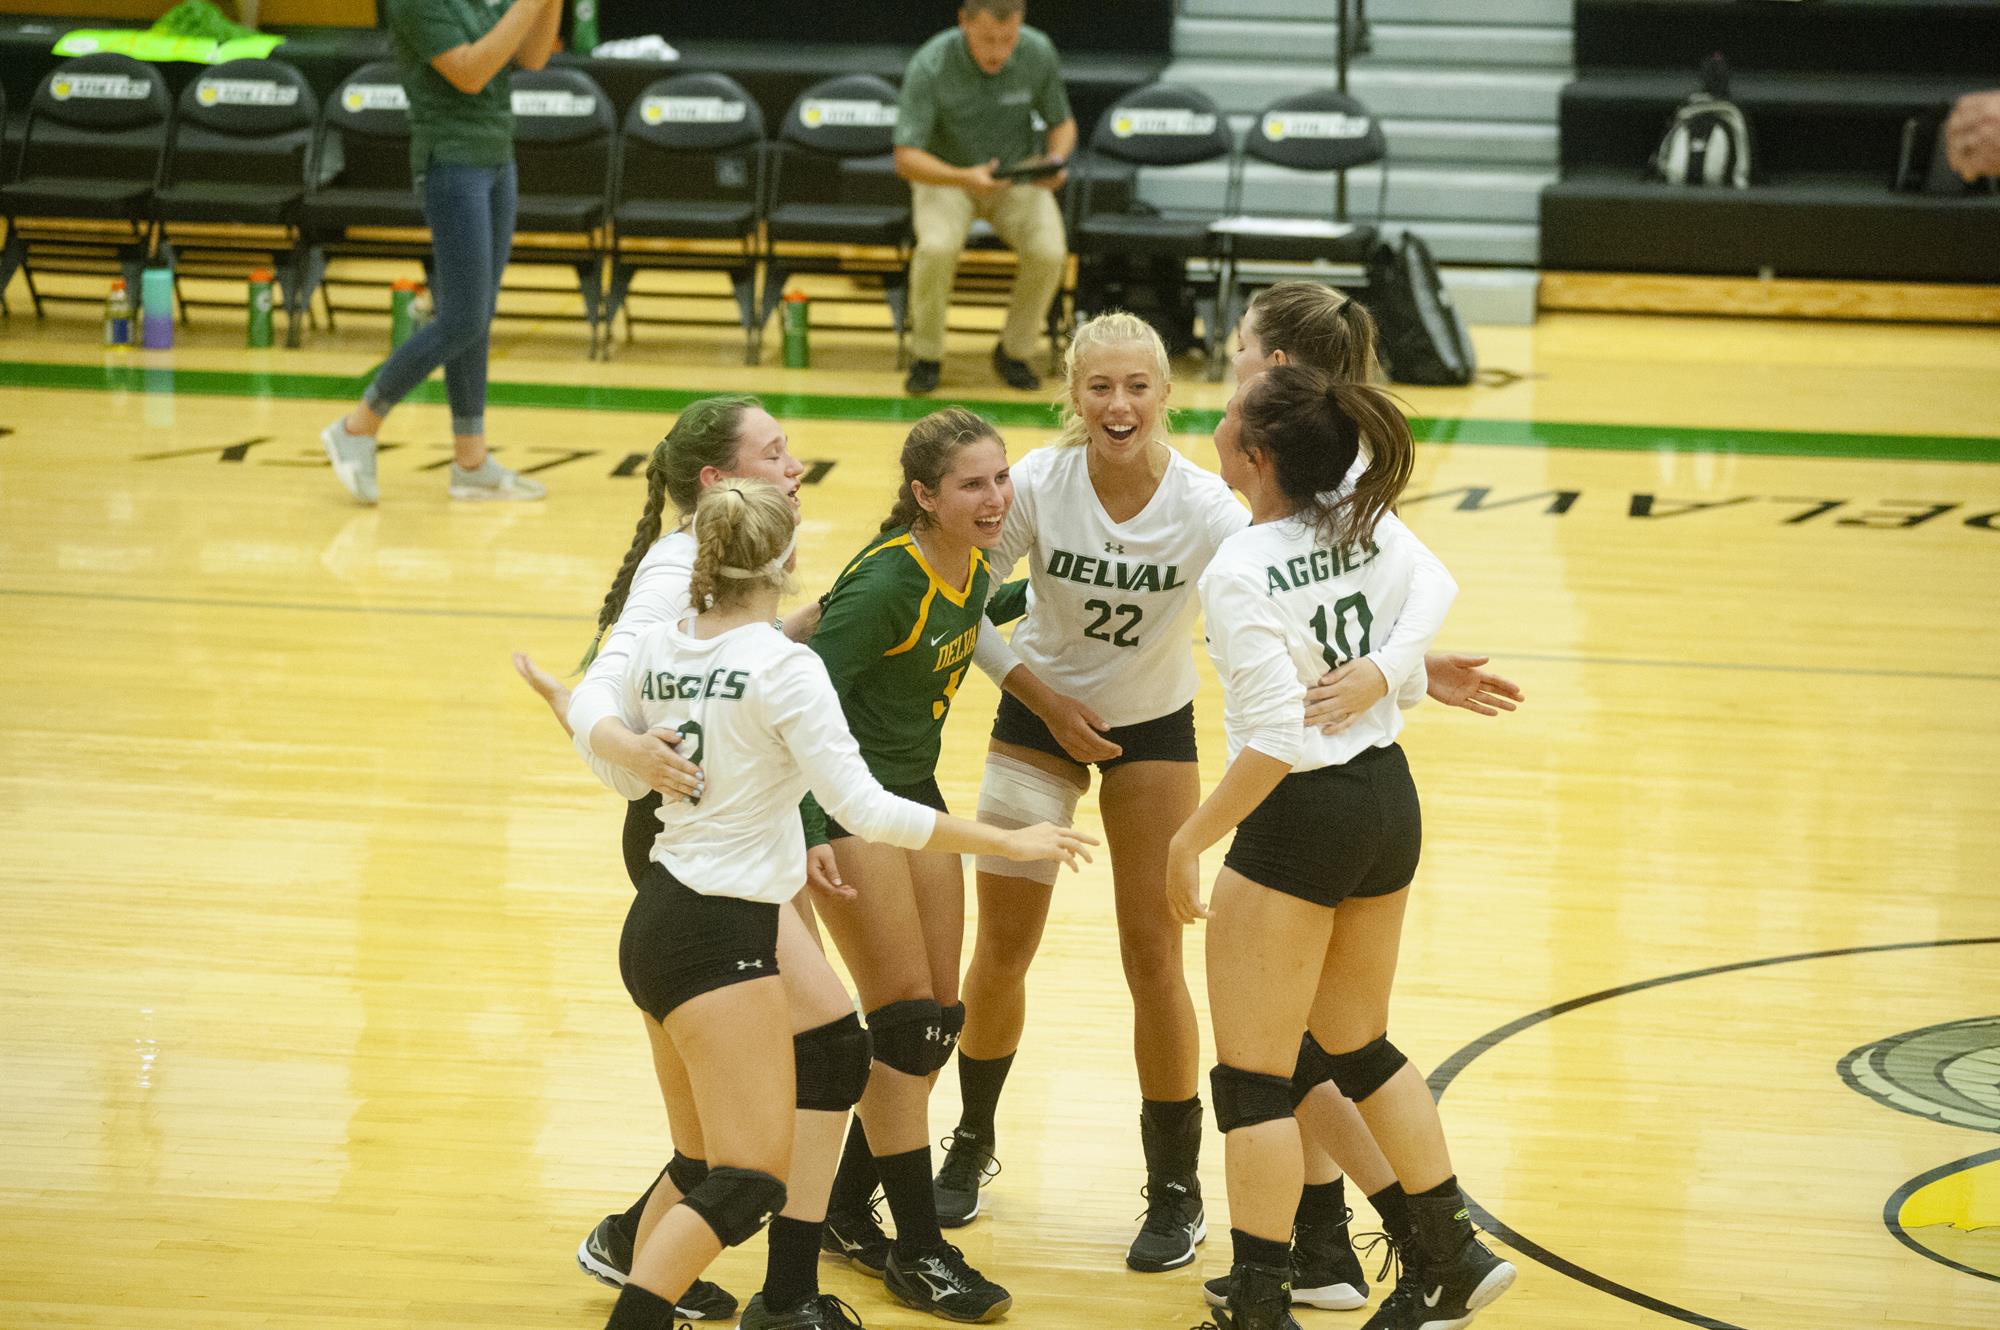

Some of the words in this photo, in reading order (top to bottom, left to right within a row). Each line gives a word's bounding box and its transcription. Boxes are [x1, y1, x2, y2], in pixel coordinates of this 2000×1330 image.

[1047, 548, 1187, 593] DELVAL
[1084, 598, 1143, 648] 22
[1309, 590, 1374, 674] 10
[640, 668, 750, 701] AGGES
[932, 665, 966, 720] 5
